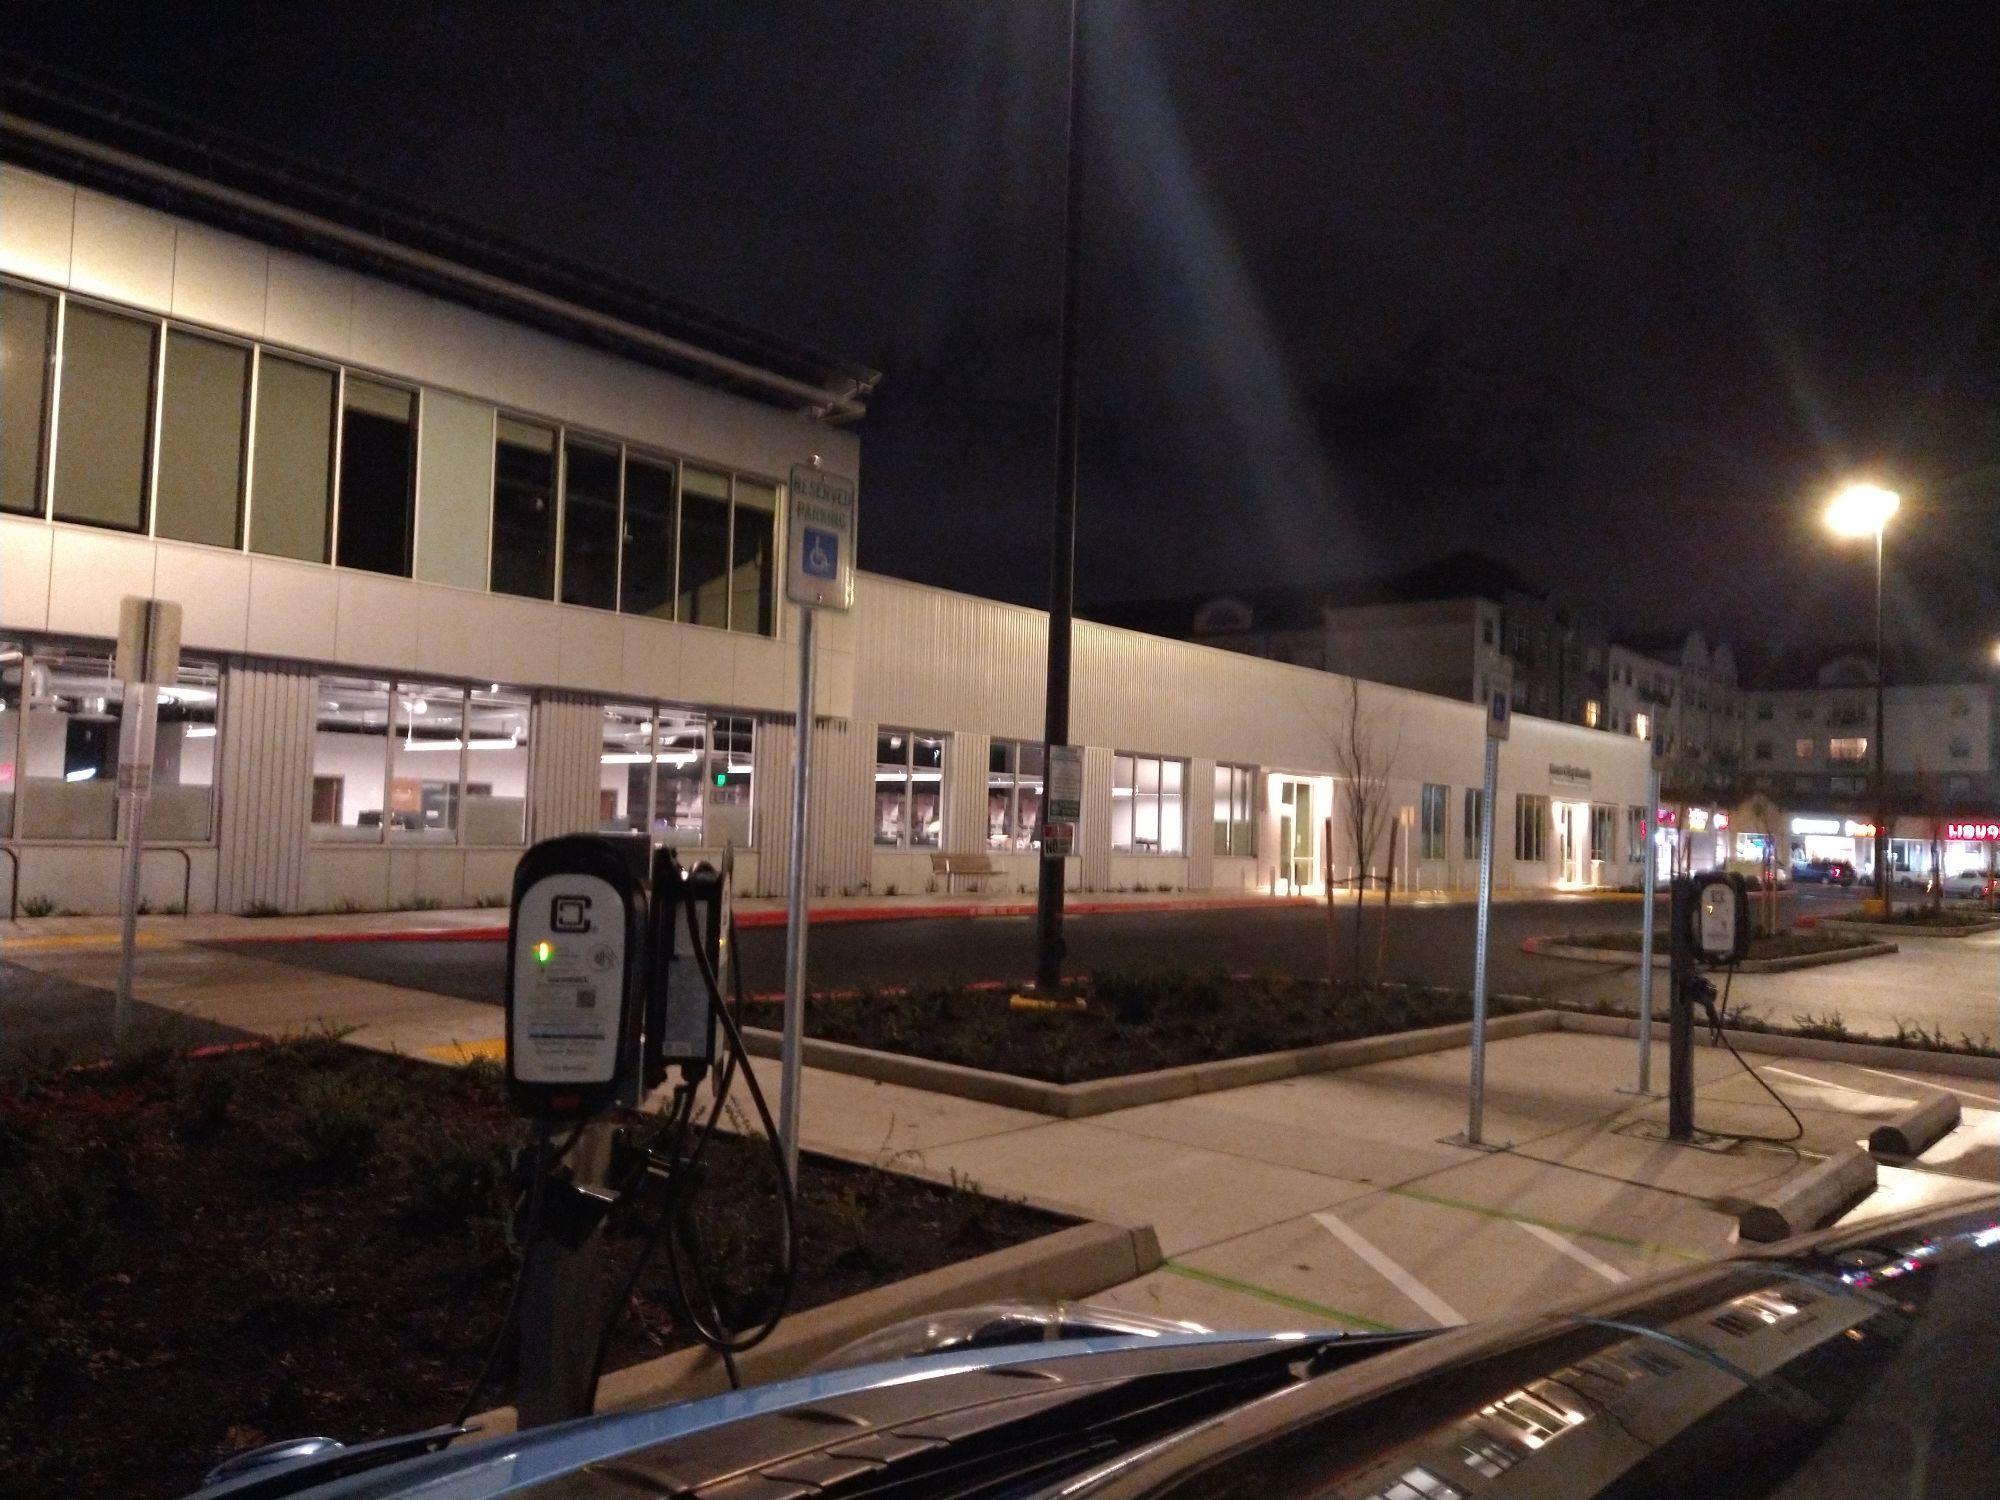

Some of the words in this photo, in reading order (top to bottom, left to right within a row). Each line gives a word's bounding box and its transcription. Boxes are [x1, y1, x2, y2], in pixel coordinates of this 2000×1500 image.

[793, 475, 852, 505] RESERVED
[796, 500, 847, 529] PARKING
[1948, 824, 2000, 840] LIQUO
